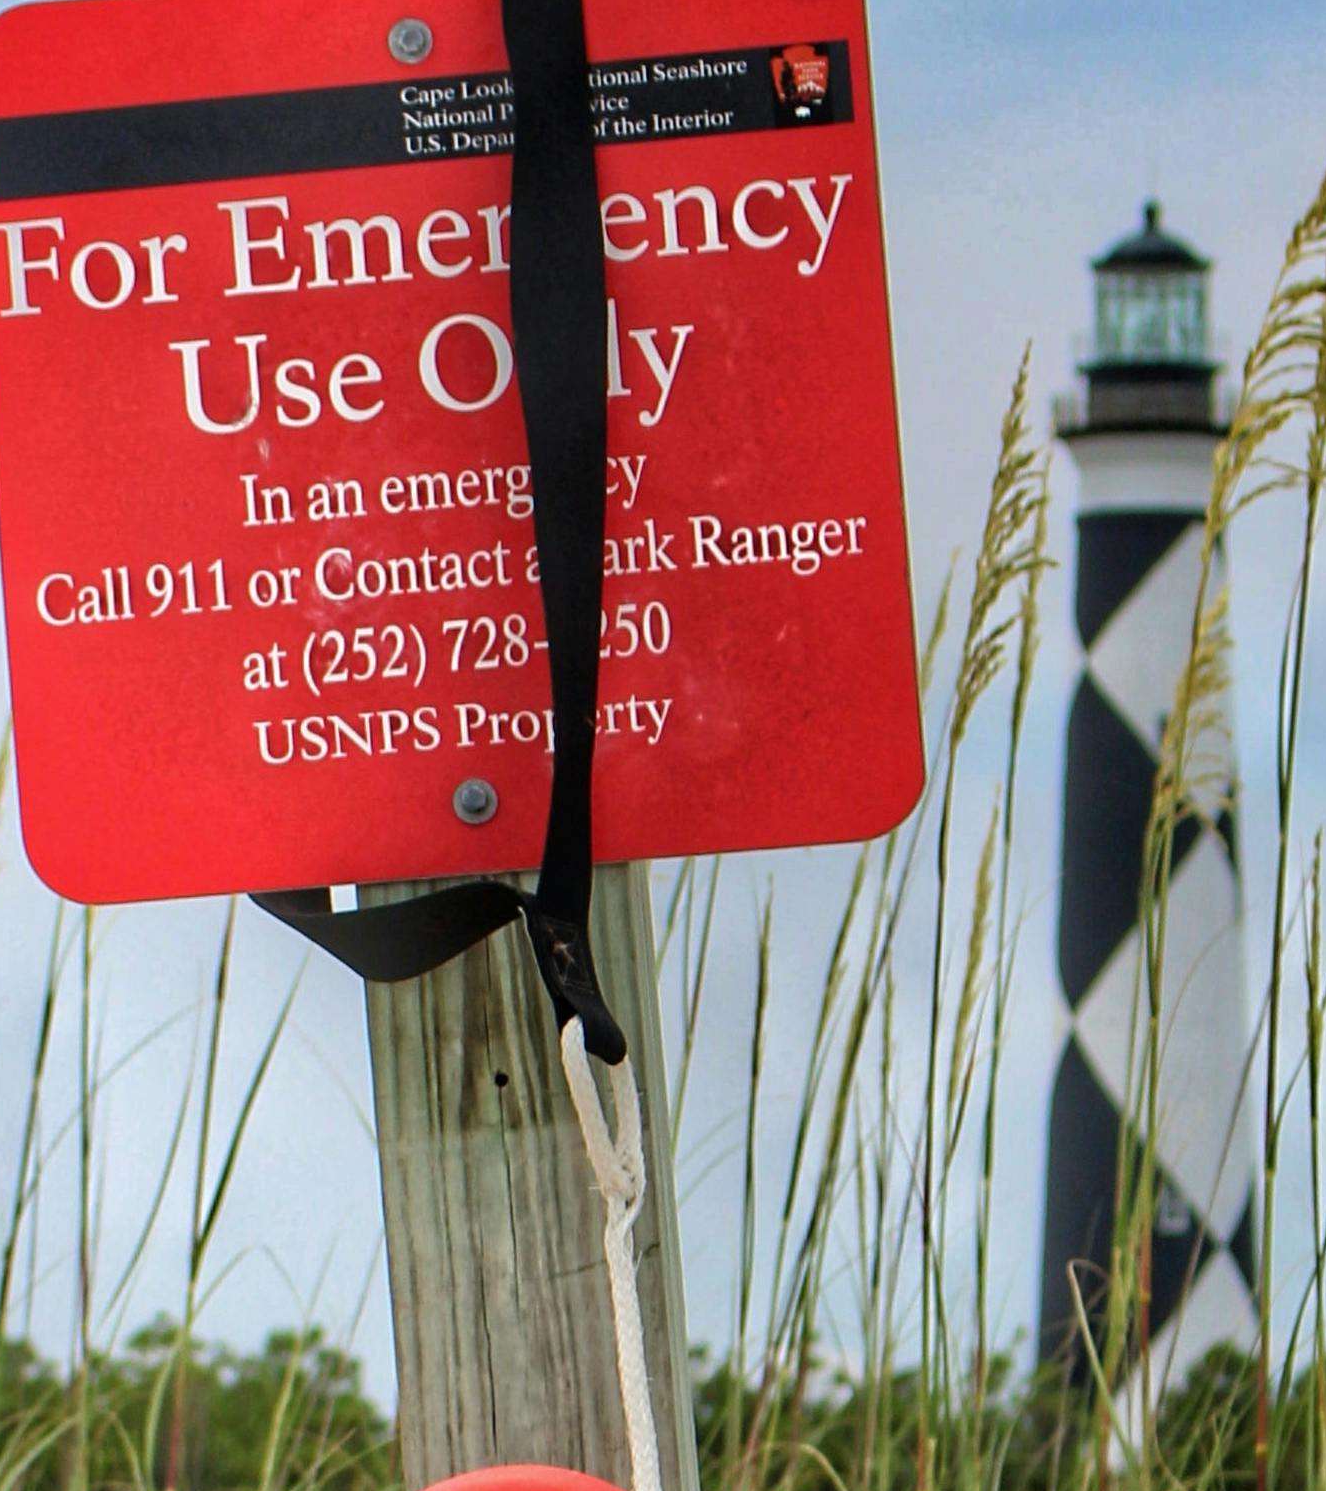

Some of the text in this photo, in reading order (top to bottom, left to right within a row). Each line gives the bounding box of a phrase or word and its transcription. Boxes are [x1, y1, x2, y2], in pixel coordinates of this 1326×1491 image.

[400, 59, 748, 108] Cape Look tional Seashore
[402, 103, 494, 130] National
[589, 94, 630, 113] vice
[405, 134, 447, 155] U.S.
[613, 116, 647, 136] the
[652, 109, 735, 133] Interior
[216, 171, 854, 298] Emerency
[169, 297, 695, 435] Use Oly
[239, 454, 647, 527] In an emergcy
[36, 565, 135, 627] Call
[145, 558, 233, 618] 911
[248, 565, 302, 608] or
[314, 539, 512, 602] Contact
[603, 518, 678, 578] ark
[688, 514, 867, 577] Ranger
[243, 600, 672, 698] at (252) 728-50
[253, 693, 673, 765] USNPS Prorty
